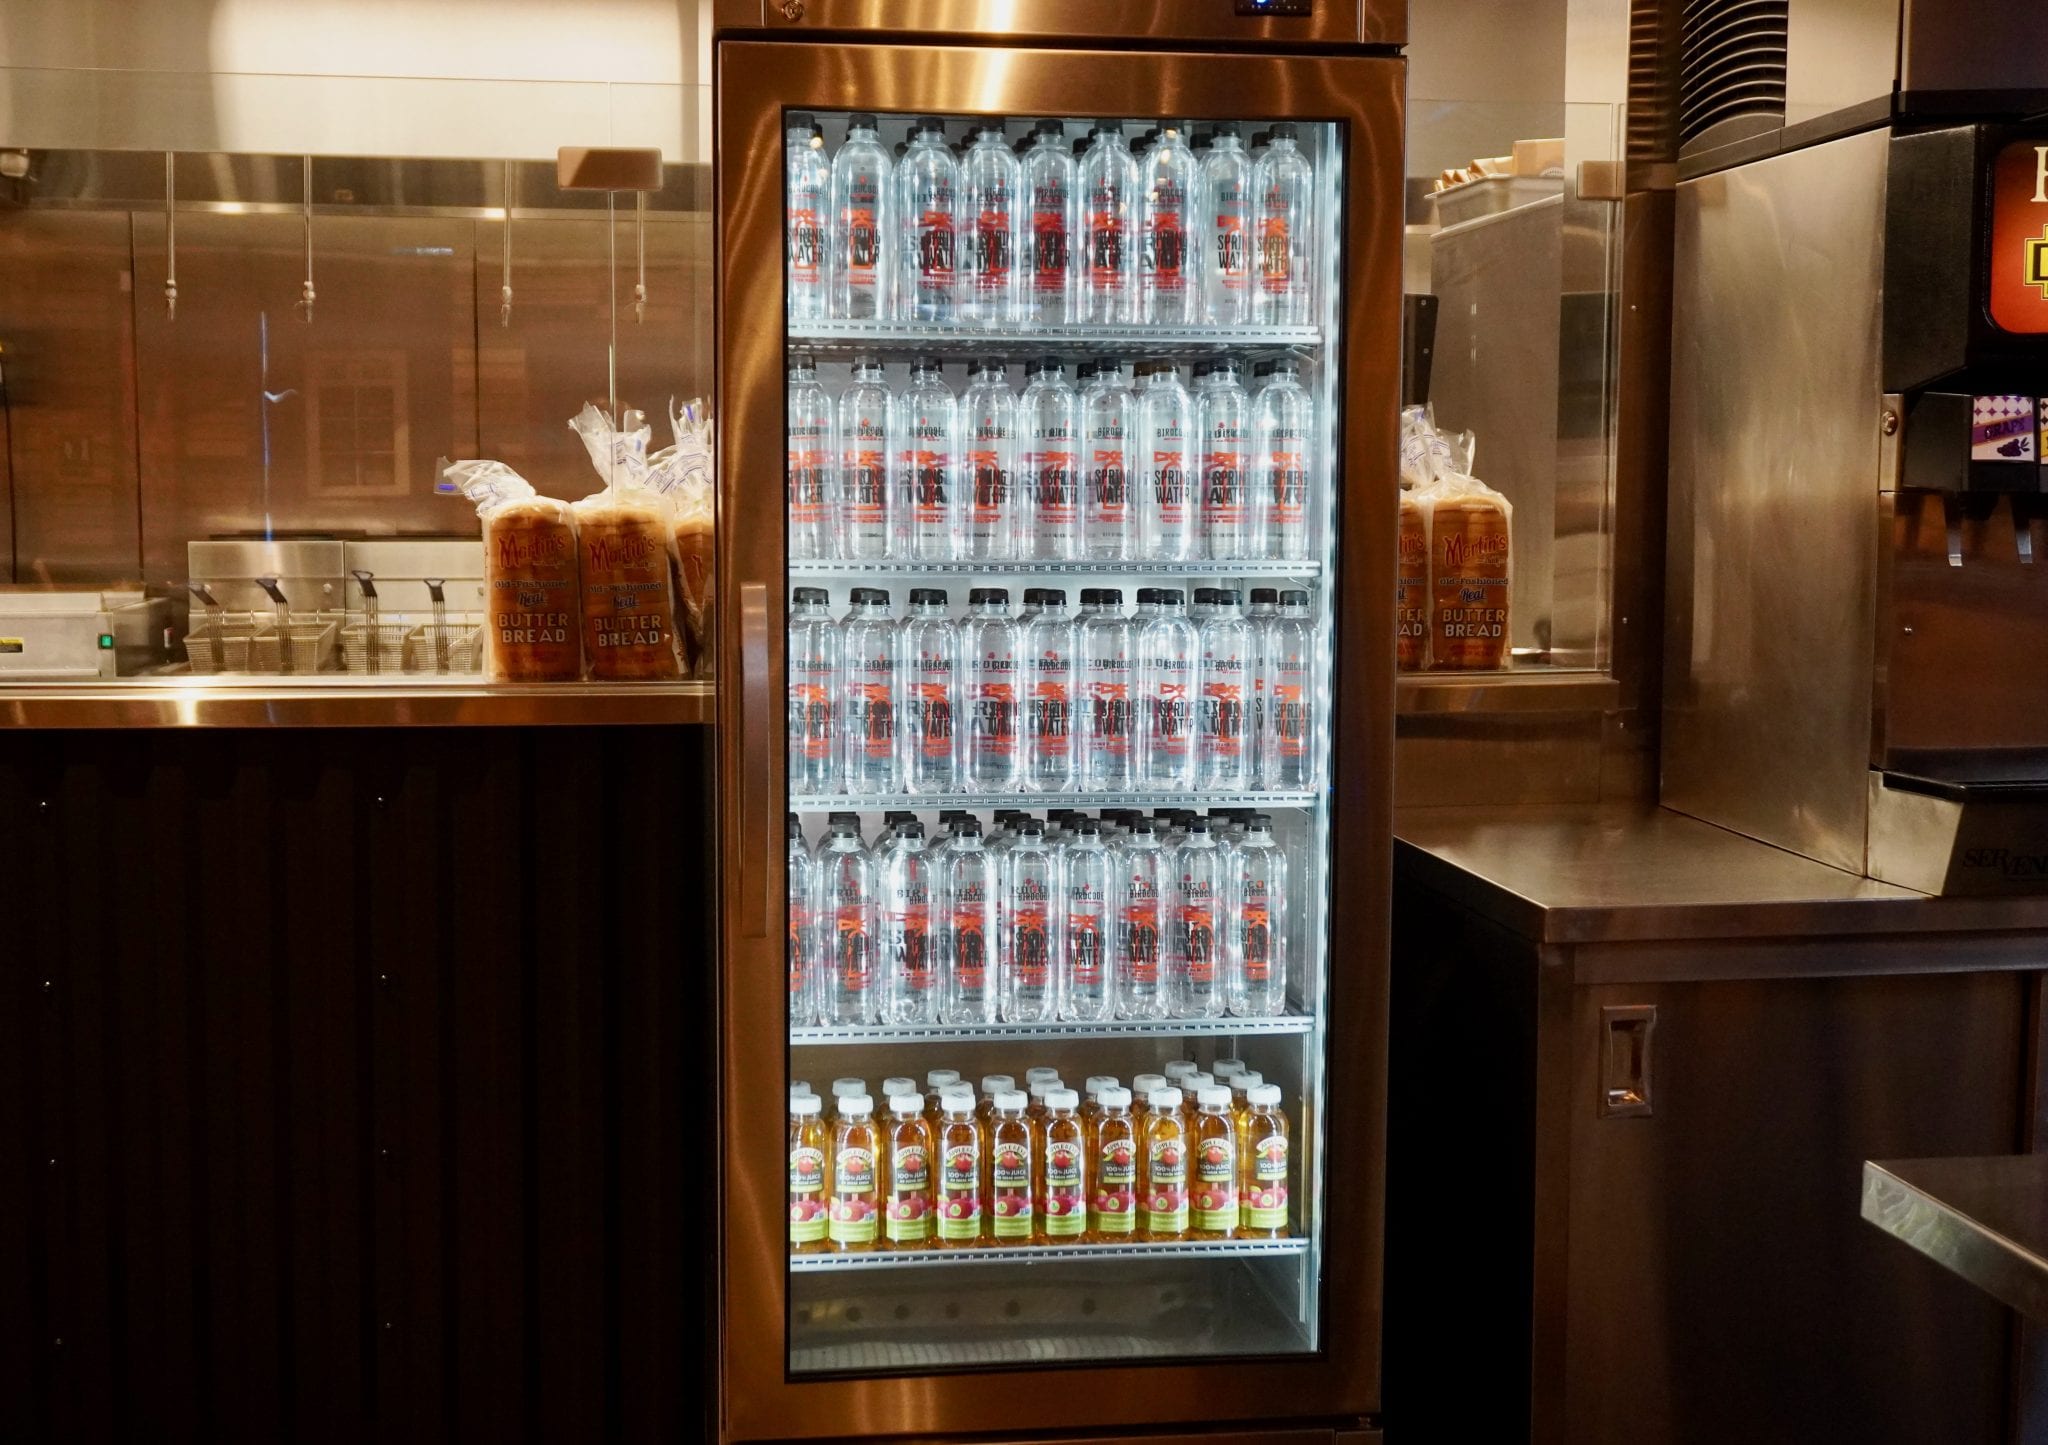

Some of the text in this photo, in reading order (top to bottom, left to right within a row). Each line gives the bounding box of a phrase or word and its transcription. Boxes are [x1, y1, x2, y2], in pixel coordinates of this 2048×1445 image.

[1154, 470, 1190, 485] SPRING
[498, 533, 566, 569] Martin's
[589, 536, 656, 573] Martin's
[1443, 533, 1507, 567] Martin's
[498, 613, 568, 627] BUTTER
[594, 615, 662, 631] BUTTER
[1443, 609, 1506, 622] BUTTER
[502, 629, 566, 643] BREAD
[1445, 624, 1502, 637] BREAD
[598, 631, 659, 646] BREAD
[1037, 702, 1073, 717] SPRING
[1275, 703, 1312, 718] SPRING
